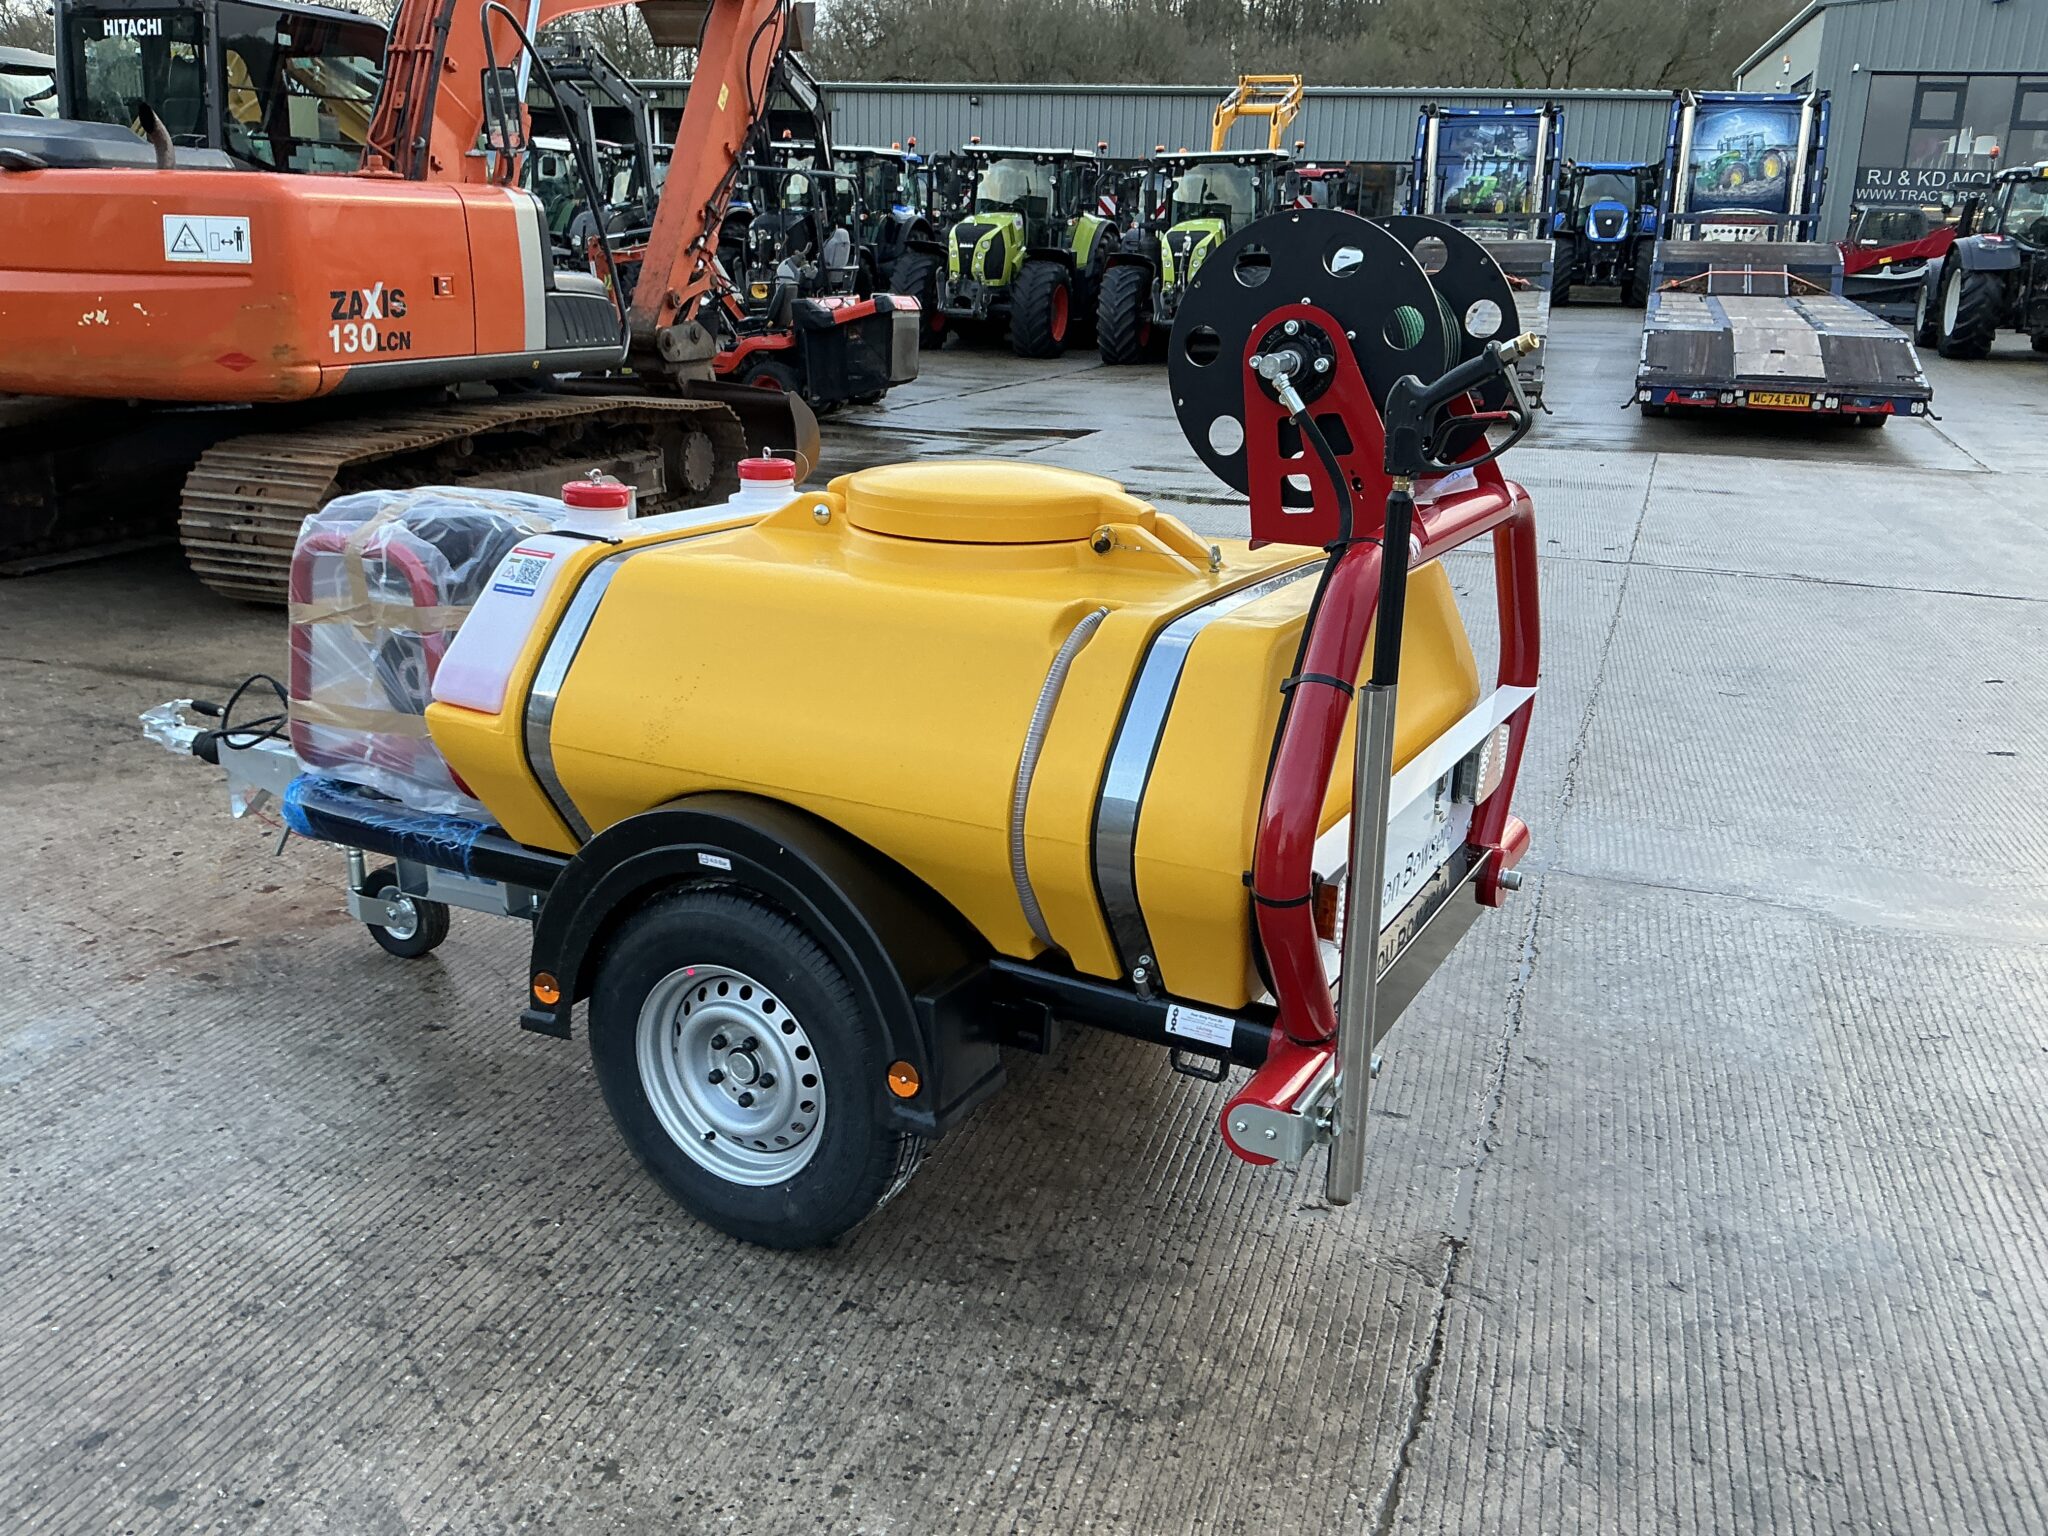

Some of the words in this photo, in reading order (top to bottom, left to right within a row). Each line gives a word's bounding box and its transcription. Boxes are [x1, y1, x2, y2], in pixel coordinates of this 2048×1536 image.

[103, 18, 163, 36] HITACHI
[1867, 169, 1893, 186] RJ
[1897, 170, 1911, 186] &
[1917, 171, 1946, 187] KD
[329, 281, 407, 320] ZAXIS
[328, 322, 411, 354] 130LCN
[1784, 394, 1807, 405] EAN
